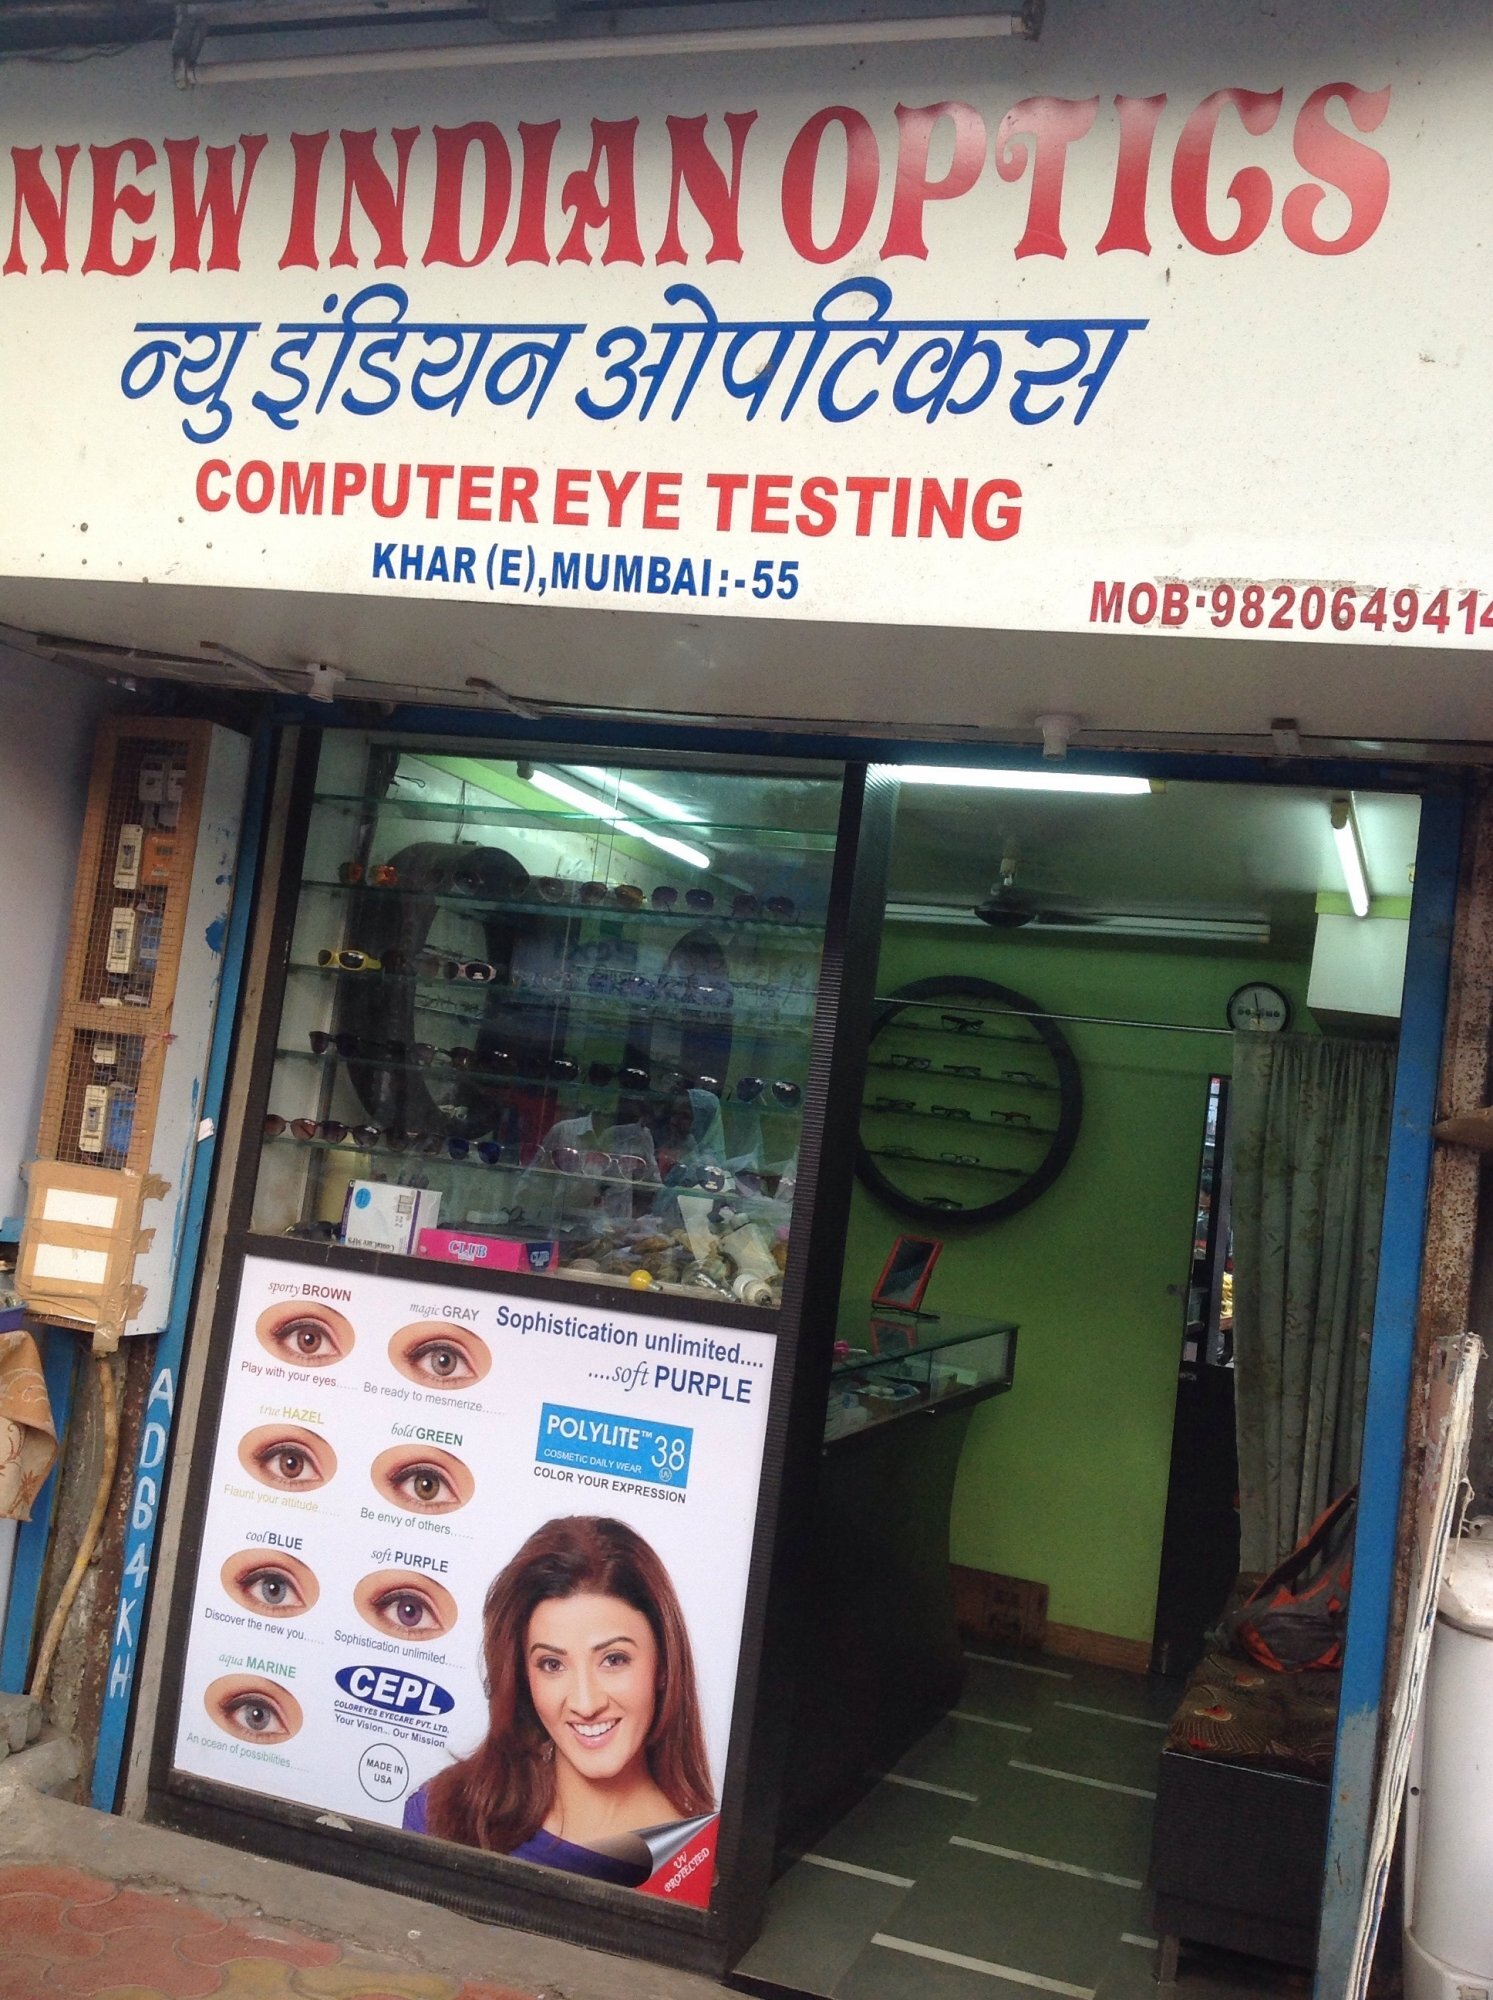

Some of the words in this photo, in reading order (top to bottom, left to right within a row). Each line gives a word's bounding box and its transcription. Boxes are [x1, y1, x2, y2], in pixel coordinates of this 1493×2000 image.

[3, 133, 268, 276] NEW
[277, 110, 758, 271] INDIAN
[781, 82, 1392, 265] OPTICS
[121, 322, 262, 444] न्यु
[252, 283, 588, 431] इंडियन
[575, 276, 1150, 427] ओपटिकस
[195, 459, 540, 524] COMPUTER
[553, 468, 683, 531] EYE
[706, 472, 1023, 541] TESTING
[372, 542, 477, 584] KHAR
[448, 1239, 488, 1259] CLUB
[267, 1280, 300, 1298] sporty
[301, 1283, 352, 1302] BROWN
[409, 1302, 441, 1318] magic
[442, 1305, 480, 1322] GRAY
[496, 1305, 638, 1347] Sophistication
[241, 1361, 263, 1376] Play
[265, 1366, 286, 1379] with
[287, 1370, 311, 1385] your
[654, 1365, 753, 1404] PURPLE
[363, 1381, 378, 1394] Be
[379, 1385, 410, 1402] ready
[411, 1390, 423, 1401] to
[259, 1404, 281, 1417] true
[282, 1406, 325, 1425] HAZEL
[390, 1422, 417, 1439] bold
[415, 1427, 464, 1447] GREEN
[543, 1448, 589, 1465] COSMETIC
[589, 1455, 615, 1469] DAILY
[615, 1461, 643, 1475] WEAR
[650, 1435, 686, 1471] 38
[223, 1483, 255, 1500] Flaunt
[256, 1493, 280, 1508] your
[533, 1466, 574, 1483] COLOR
[576, 1473, 610, 1491] YOUR
[611, 1480, 687, 1504] EXPRESSION
[360, 1507, 375, 1519] Be
[377, 1512, 403, 1528] envy
[404, 1515, 416, 1528] of
[245, 1530, 268, 1544] cool
[267, 1532, 304, 1550] BLUE
[370, 1547, 393, 1564] soft
[393, 1551, 449, 1574] PURPLE
[204, 1607, 246, 1628] Discover
[246, 1617, 263, 1630] the
[264, 1622, 285, 1635] new
[333, 1629, 401, 1655] Sophistication
[218, 1653, 244, 1667] aqua
[245, 1656, 297, 1679] MARINE
[348, 1667, 442, 1715] CEPL
[335, 1713, 355, 1726] Your
[392, 1728, 410, 1740] Our
[410, 1732, 445, 1749] Mission
[379, 1709, 414, 1726] EYECARE
[415, 1720, 432, 1730] PVT.
[433, 1723, 450, 1734] LTD.
[186, 1732, 200, 1744] An
[200, 1736, 228, 1752] ocean
[229, 1743, 240, 1755] of
[366, 1758, 392, 1773] MADE
[393, 1765, 404, 1775] IN
[373, 1773, 393, 1786] USA
[664, 1847, 710, 1893] PROTECTED
[673, 1851, 687, 1869] UV
